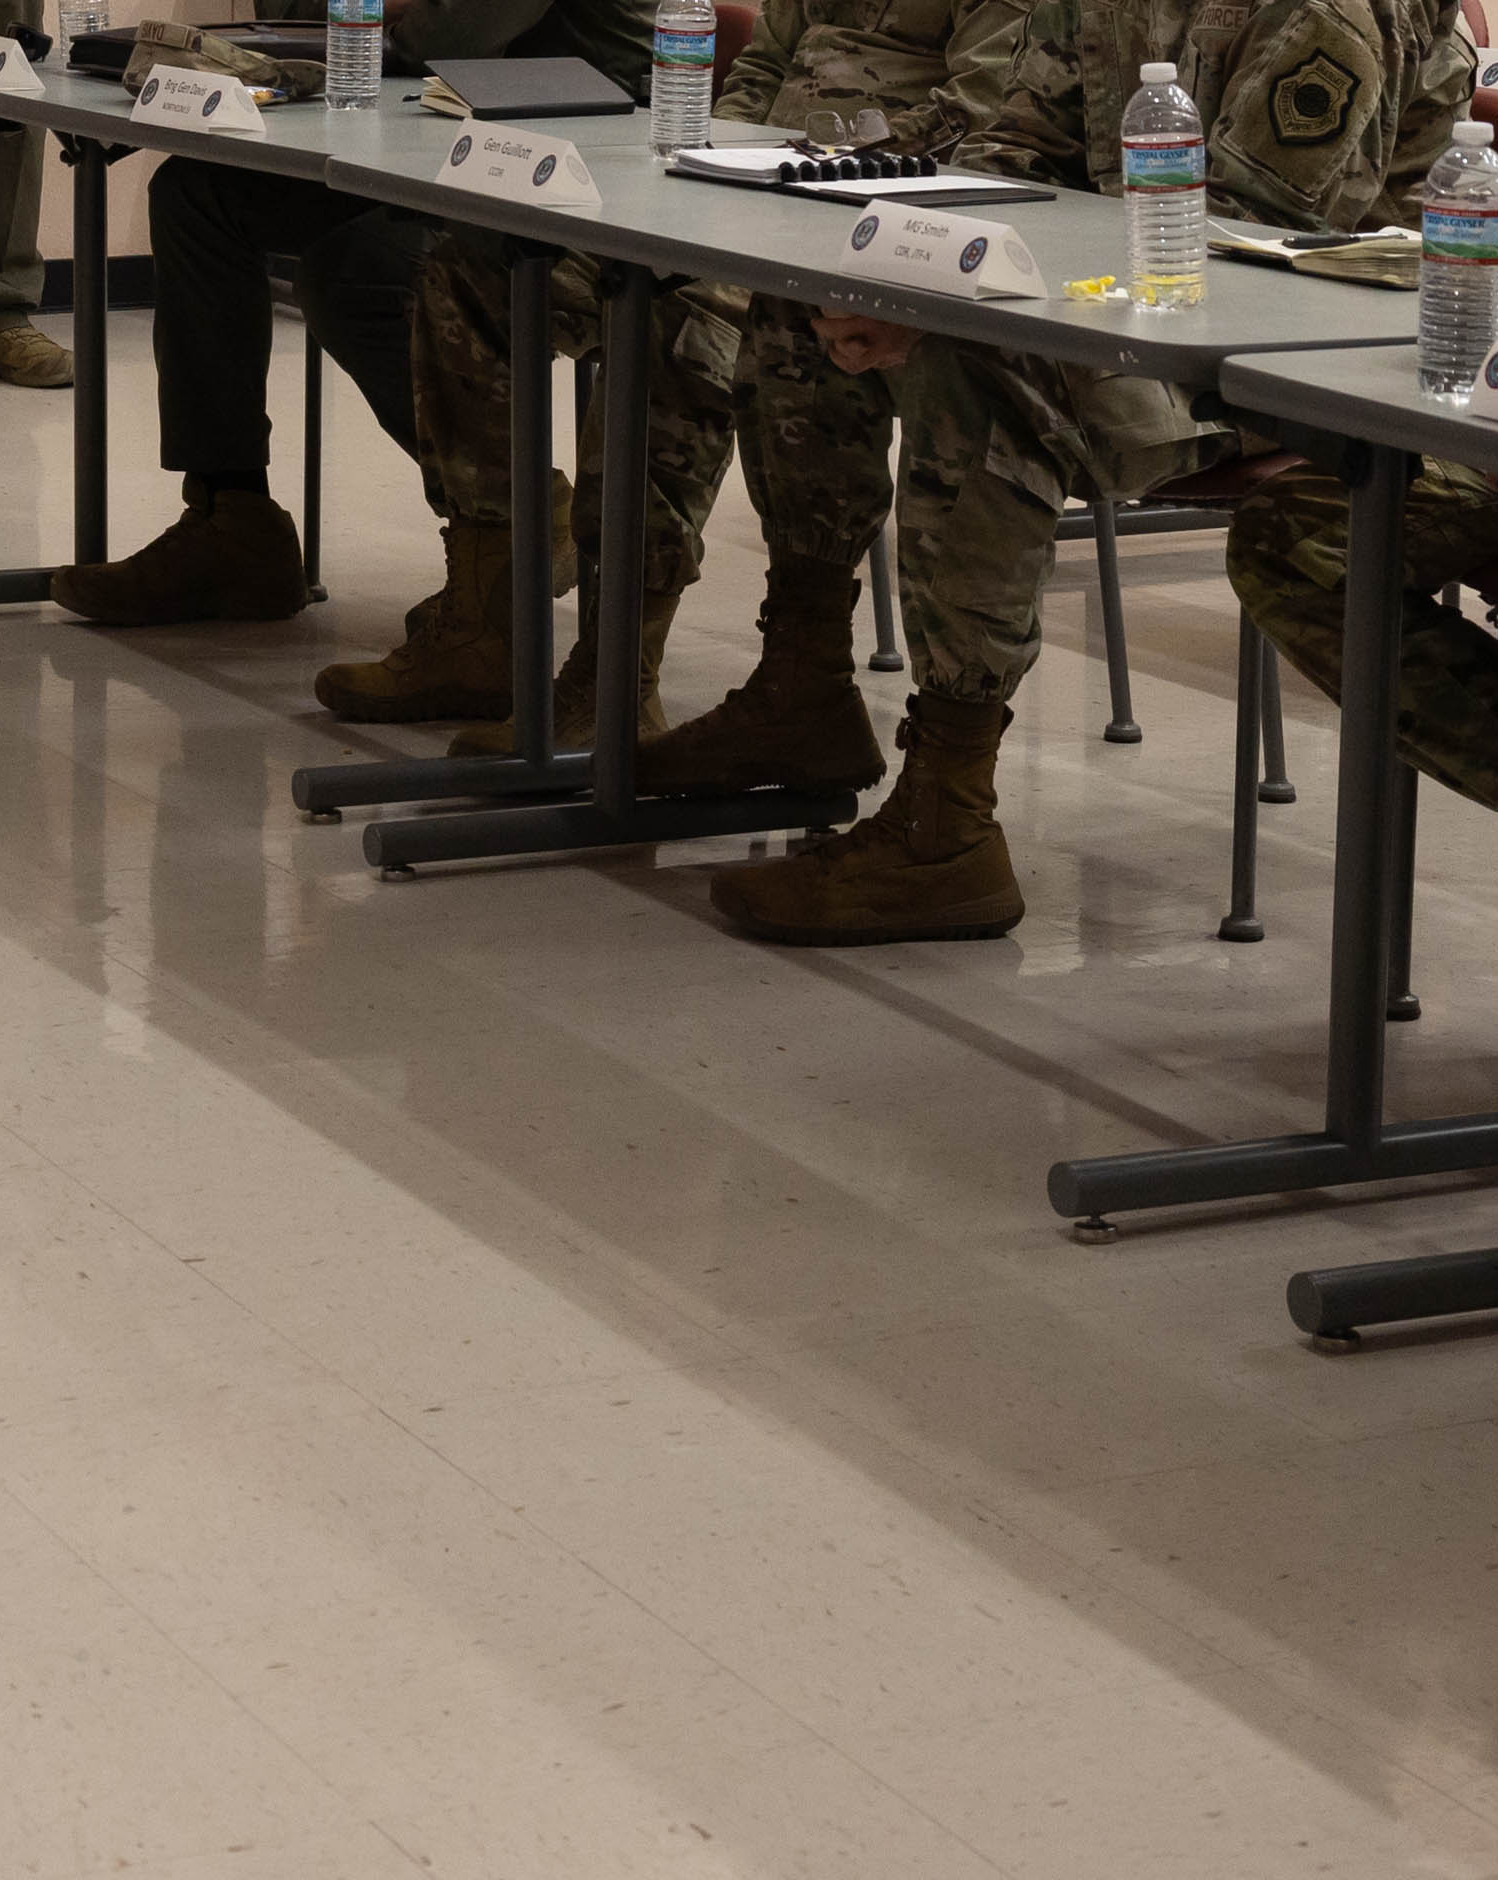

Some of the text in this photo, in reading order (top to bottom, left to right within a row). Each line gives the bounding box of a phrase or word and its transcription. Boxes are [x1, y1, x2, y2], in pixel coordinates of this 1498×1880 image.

[164, 79, 208, 96] Brig Gen Davis
[484, 137, 501, 152] Gen
[1160, 150, 1189, 159] GEYSER
[903, 218, 950, 238] MG Smith
